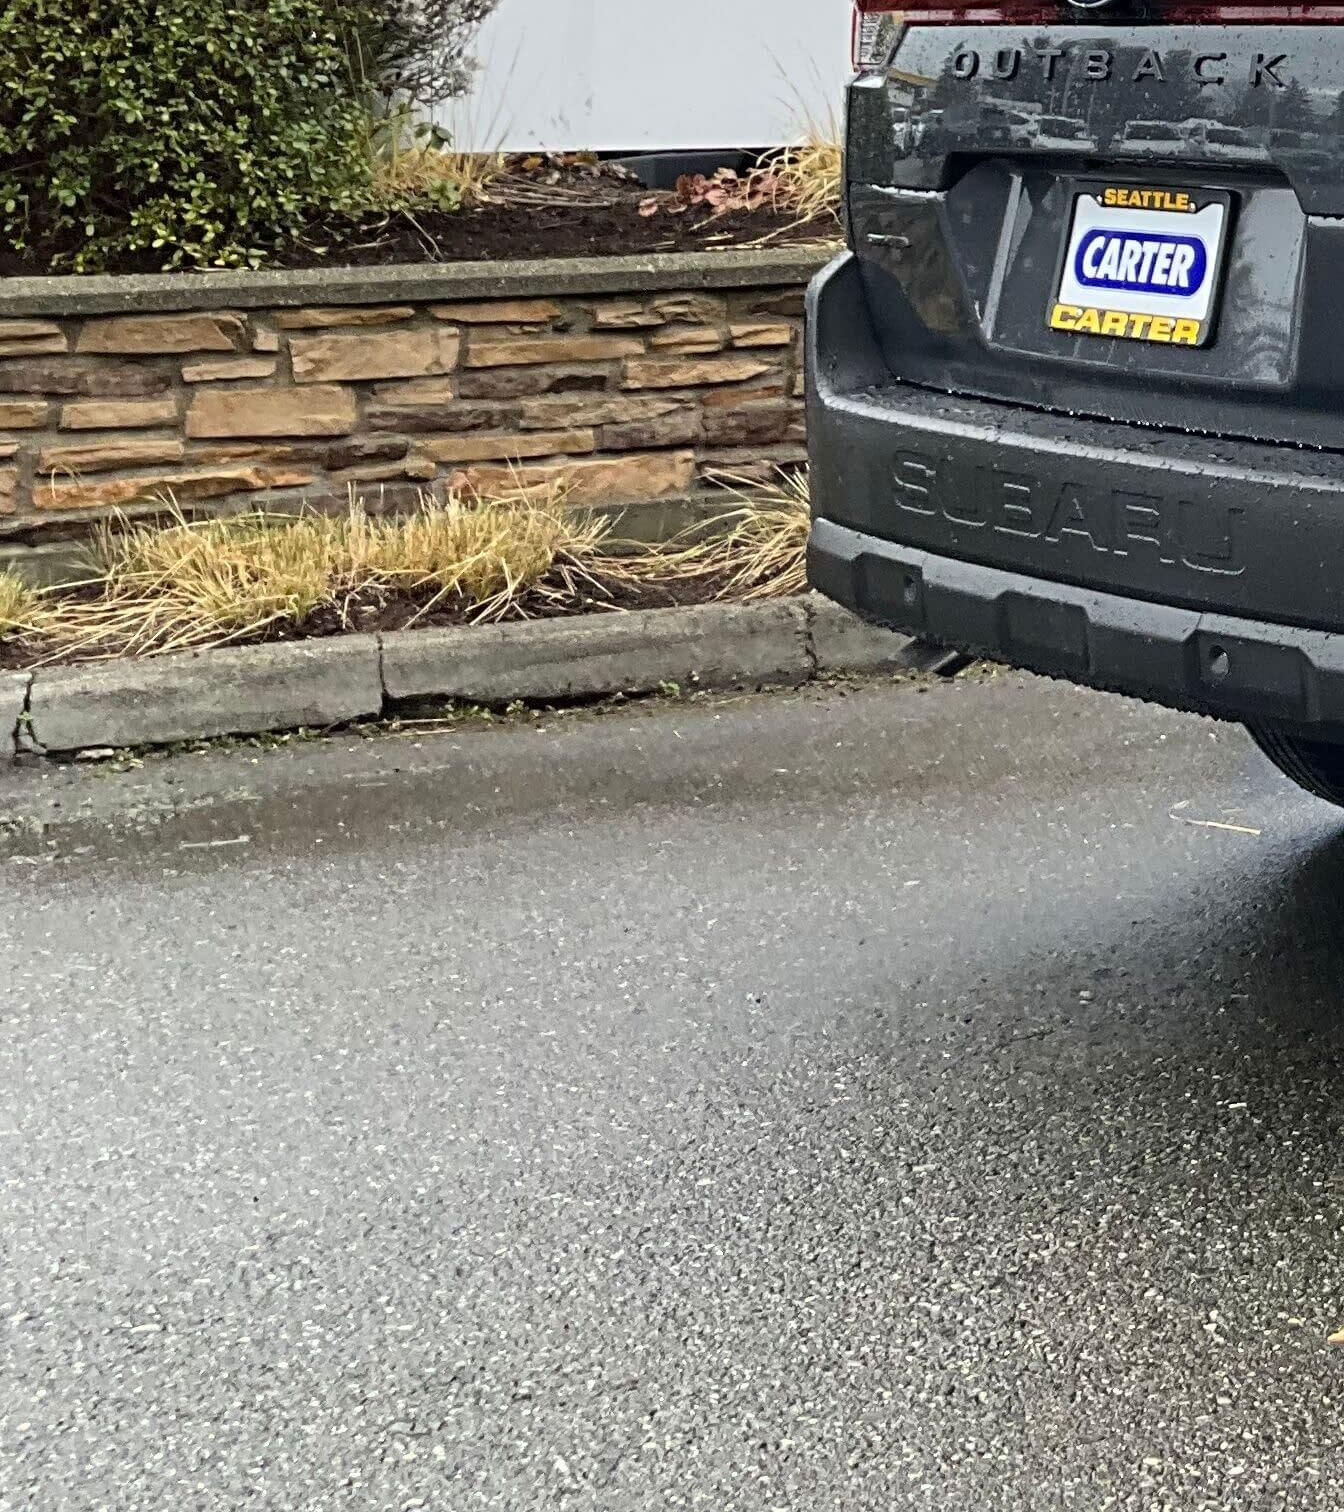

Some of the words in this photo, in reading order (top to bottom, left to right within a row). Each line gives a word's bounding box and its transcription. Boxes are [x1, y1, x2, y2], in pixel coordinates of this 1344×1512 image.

[953, 48, 1291, 90] OUTBACK
[1104, 188, 1190, 211] SEATTLE
[1082, 235, 1195, 288] CARTER
[1050, 304, 1201, 345] CARTER
[894, 450, 1246, 575] SUBARU
